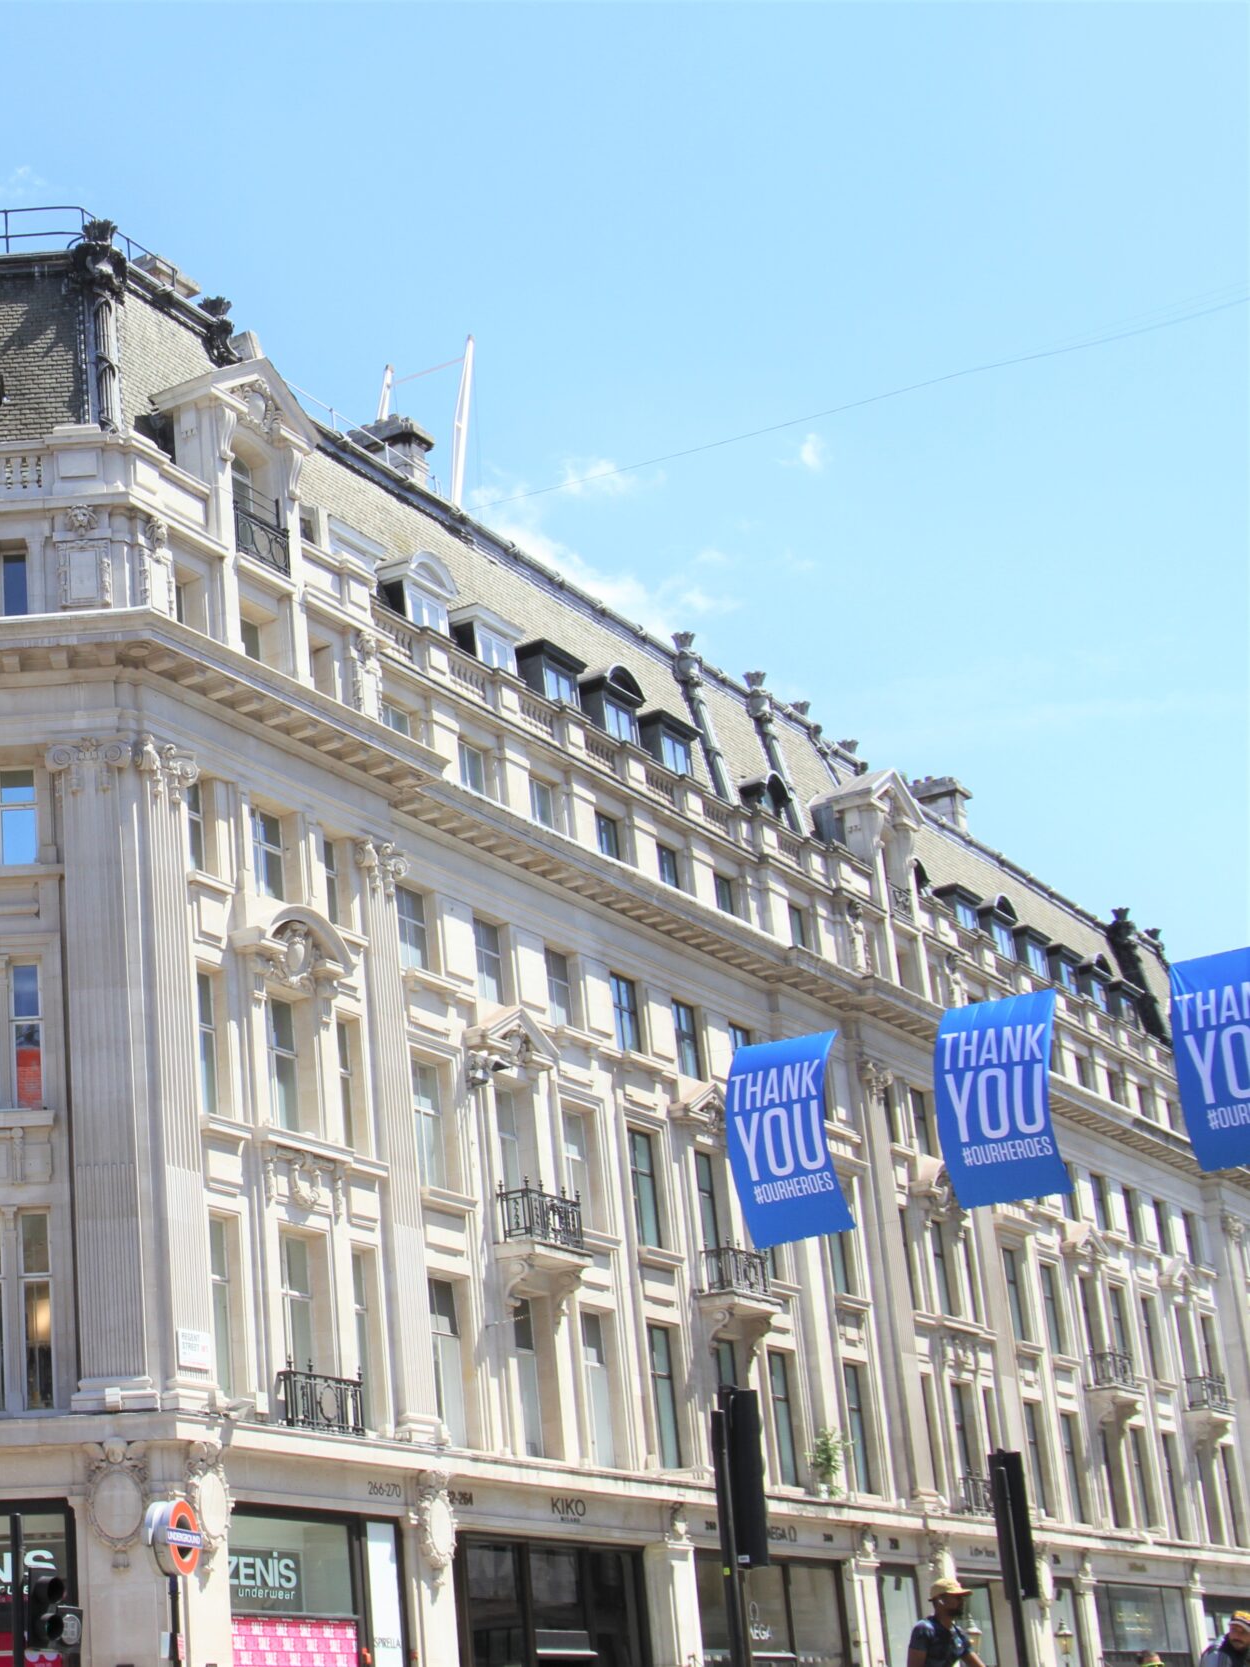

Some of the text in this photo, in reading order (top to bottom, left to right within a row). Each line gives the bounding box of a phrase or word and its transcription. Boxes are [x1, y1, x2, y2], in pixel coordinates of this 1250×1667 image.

[941, 1024, 1046, 1070] THANK
[731, 1059, 821, 1113] THANK
[944, 1063, 1046, 1143] YOU
[1207, 1102, 1250, 1130] #OUR
[734, 1100, 826, 1182] YOU
[962, 1136, 1053, 1167] #OURHEROES
[753, 1171, 835, 1205] #OURHEROES
[368, 1481, 401, 1498] 266-270
[448, 1490, 473, 1506] 2-264
[550, 1496, 586, 1517] KIKO
[238, 1587, 296, 1599] underwear
